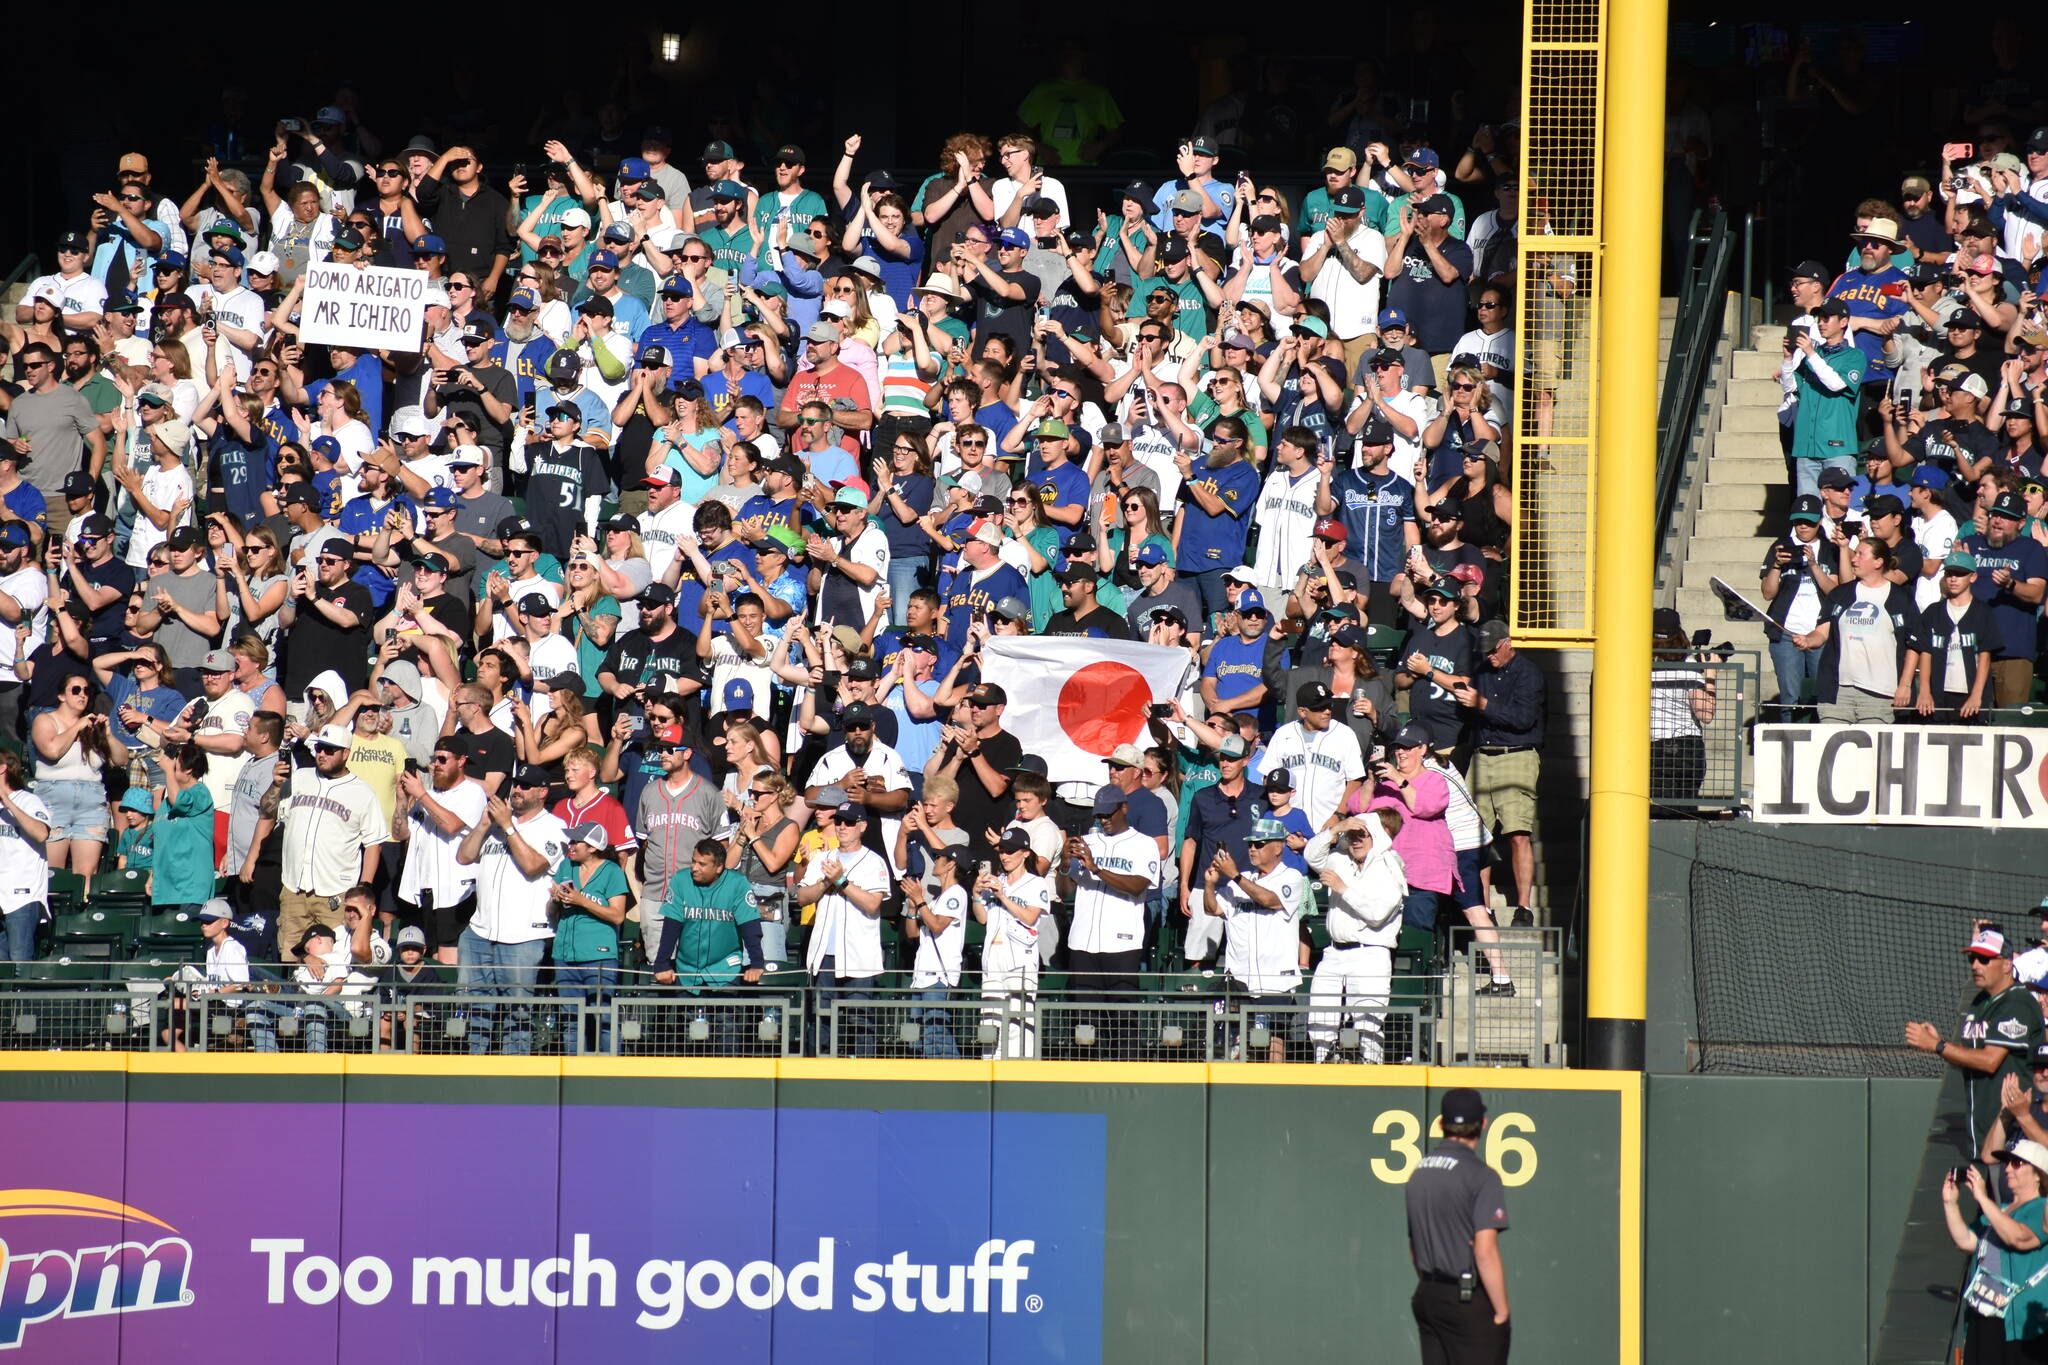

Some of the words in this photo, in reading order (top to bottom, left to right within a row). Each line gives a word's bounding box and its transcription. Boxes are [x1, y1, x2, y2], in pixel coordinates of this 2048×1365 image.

[308, 269, 350, 292] DOMO
[354, 274, 423, 300] ARIGATO
[1836, 284, 1887, 311] eattle
[314, 302, 340, 327] MR
[347, 302, 411, 333] ICHIRO
[559, 481, 583, 511] 51
[619, 655, 681, 673] MARINER
[1282, 753, 1342, 774] MARINERS
[1761, 729, 2048, 820] ICHIR
[290, 794, 352, 822] MARINERS
[648, 812, 700, 831] MARINERS
[1093, 856, 1133, 873] RINERS
[1370, 1109, 1538, 1188] 36
[250, 1238, 393, 1306] Too
[411, 1233, 617, 1307] much
[635, 1236, 835, 1330] good
